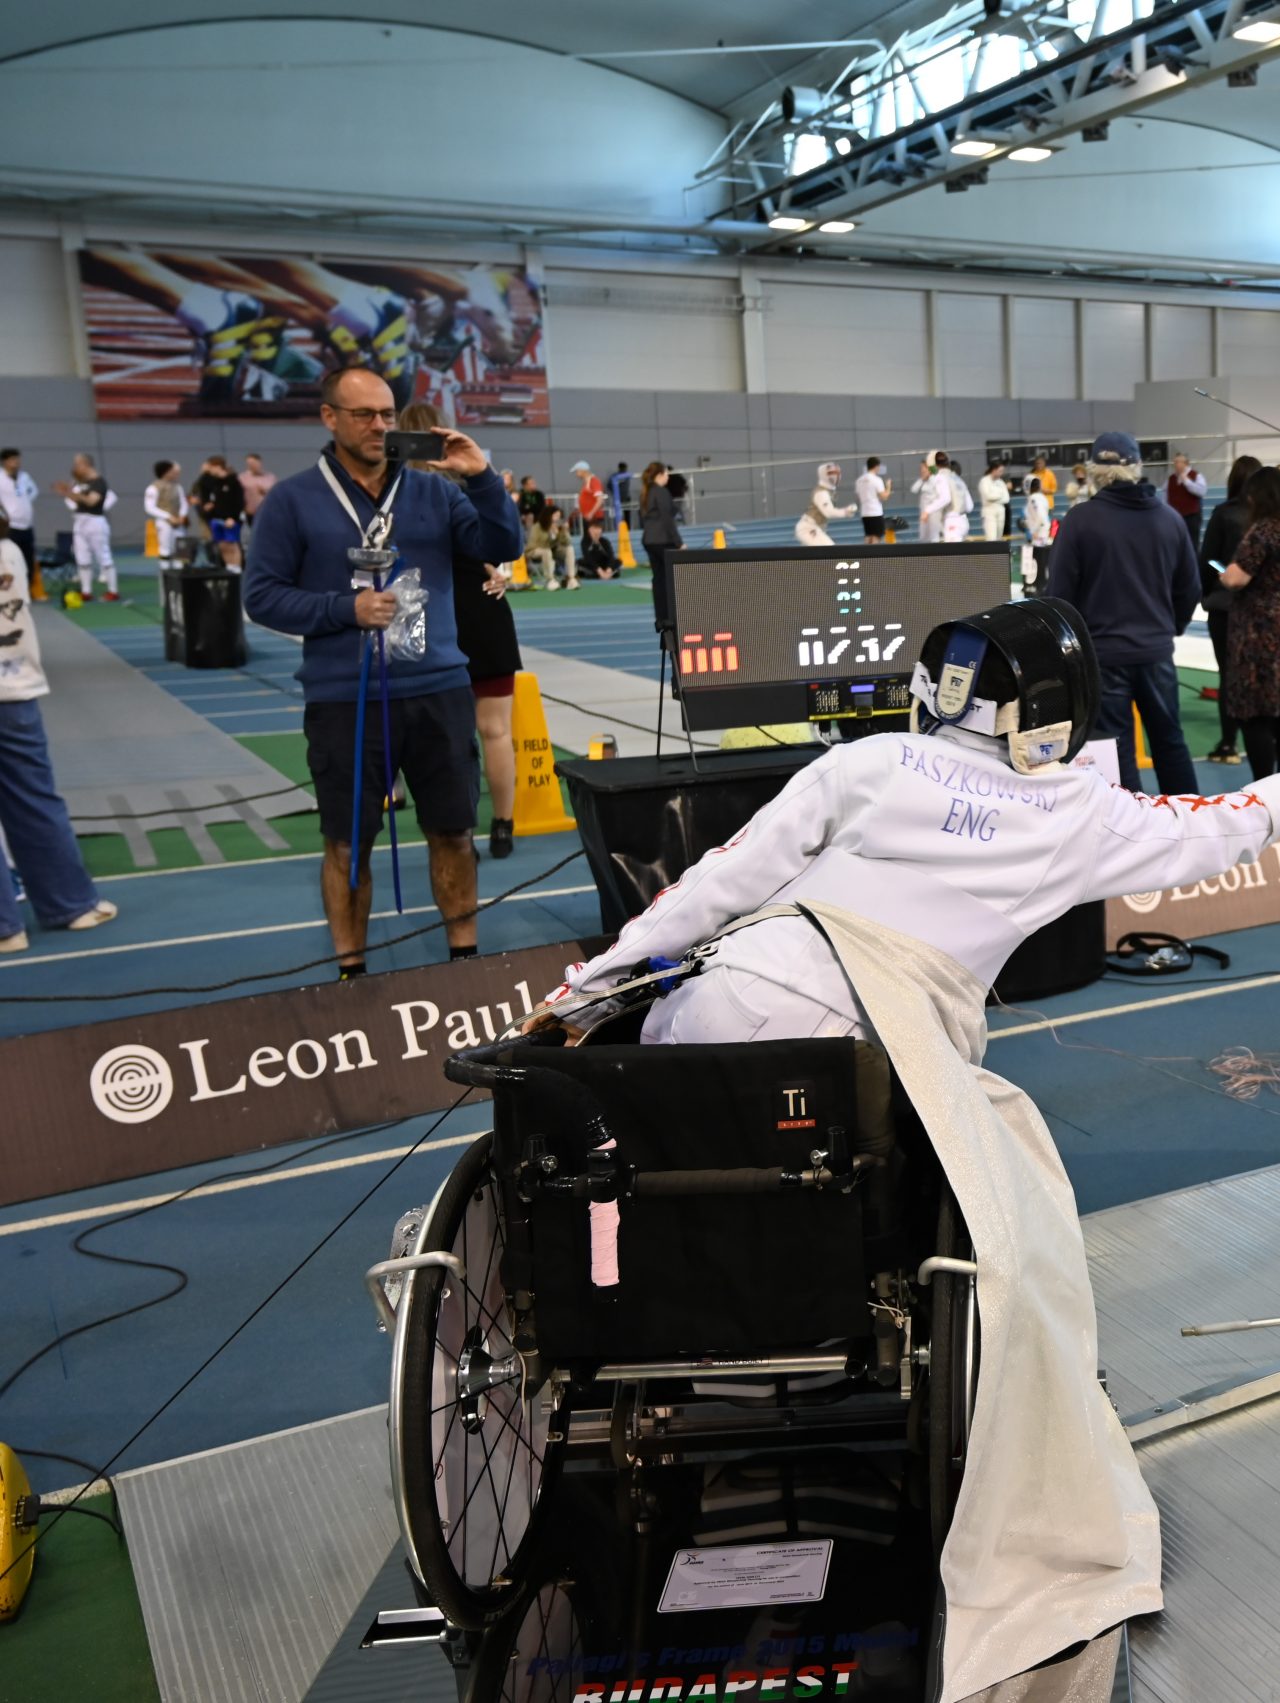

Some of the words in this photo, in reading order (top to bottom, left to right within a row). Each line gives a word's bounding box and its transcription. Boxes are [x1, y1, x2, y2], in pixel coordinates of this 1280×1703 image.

[523, 738, 549, 752] FIELD
[532, 756, 543, 769] OF
[528, 774, 551, 788] PLAY
[900, 743, 1061, 813] PASZKOWSKI
[940, 797, 1000, 842] ENG
[179, 1028, 378, 1102] Leon
[391, 979, 536, 1061] Paul
[783, 1088, 806, 1117] Ti
[573, 1662, 859, 1703] BUDAPEST
